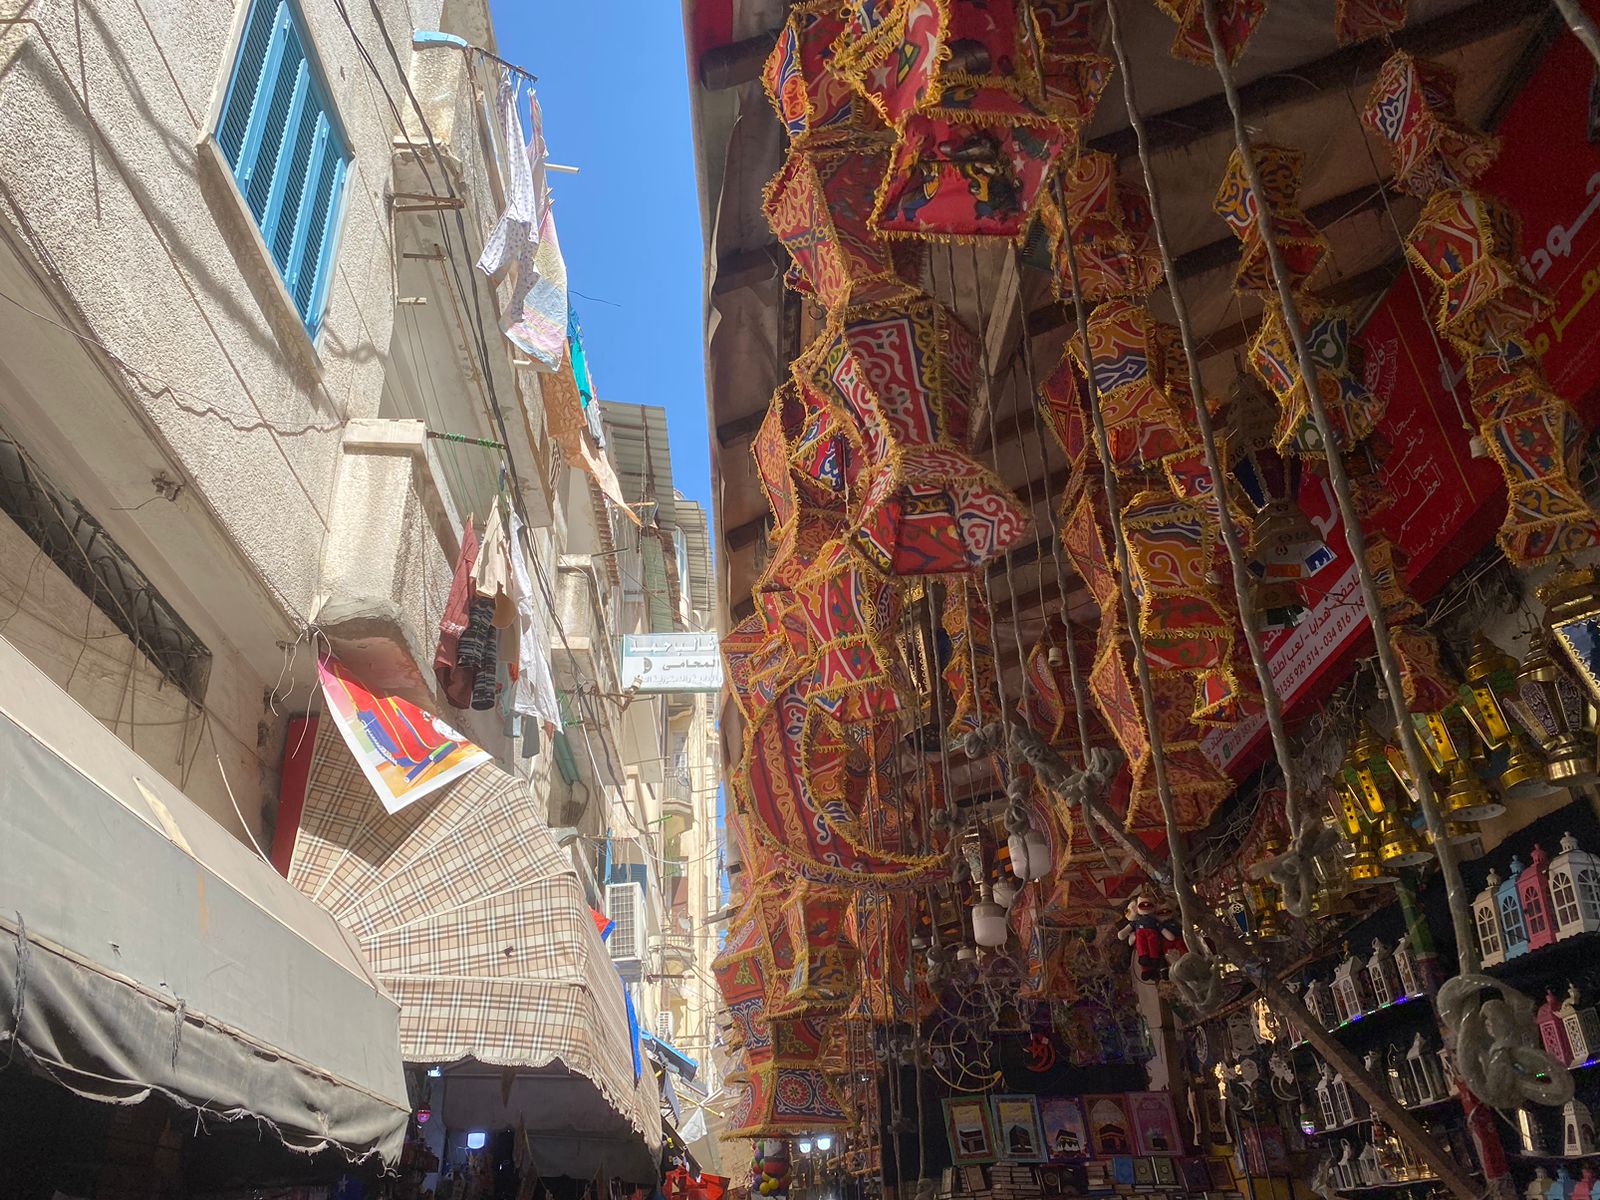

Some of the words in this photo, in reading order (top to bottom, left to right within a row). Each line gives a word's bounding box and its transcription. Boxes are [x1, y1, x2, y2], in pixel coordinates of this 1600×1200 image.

[1293, 660, 1306, 676] 929
[1306, 646, 1320, 666] 514
[1323, 627, 1337, 647] 034
[1336, 611, 1351, 633] 816
[1308, 607, 1332, 636] هدايا
